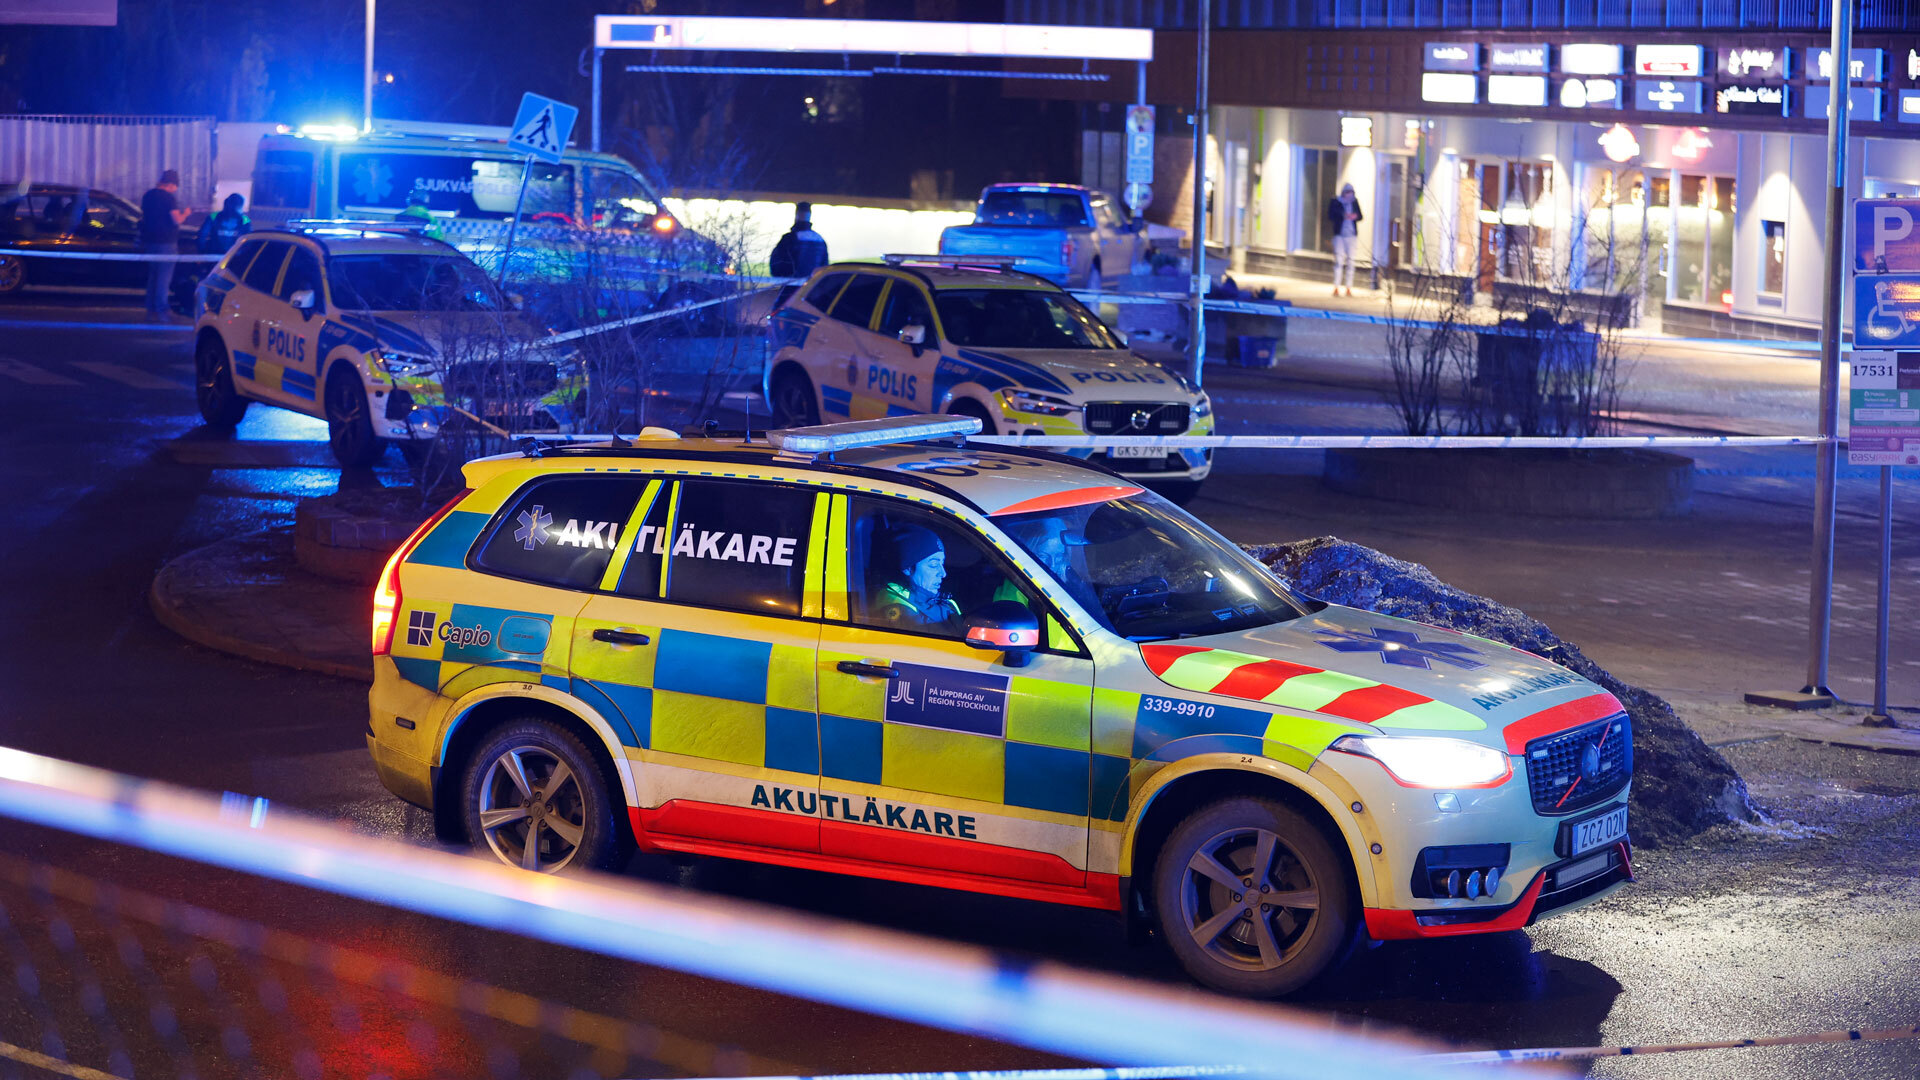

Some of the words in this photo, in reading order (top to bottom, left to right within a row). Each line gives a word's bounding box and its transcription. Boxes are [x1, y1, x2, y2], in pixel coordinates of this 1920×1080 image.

[1134, 136, 1149, 155] P
[1873, 206, 1914, 258] P
[267, 327, 305, 362] POLIS
[868, 364, 917, 401] POLIS
[1069, 371, 1165, 384] POLIS
[1853, 365, 1894, 376] 17531
[1117, 446, 1139, 456] GKS
[438, 620, 491, 649] Capio
[929, 687, 938, 696] PÅ
[939, 689, 973, 701] UPPDRAG
[974, 693, 985, 702] AV
[1472, 672, 1584, 711] AKUTLÄKARE
[928, 696, 955, 707] REGION
[956, 700, 1000, 713] STOCKHOLM
[1144, 697, 1215, 719] 339-9910
[750, 784, 977, 840] AKUTLÄKARE
[1582, 819, 1604, 848] ZCZ
[1606, 810, 1625, 839] 02N
